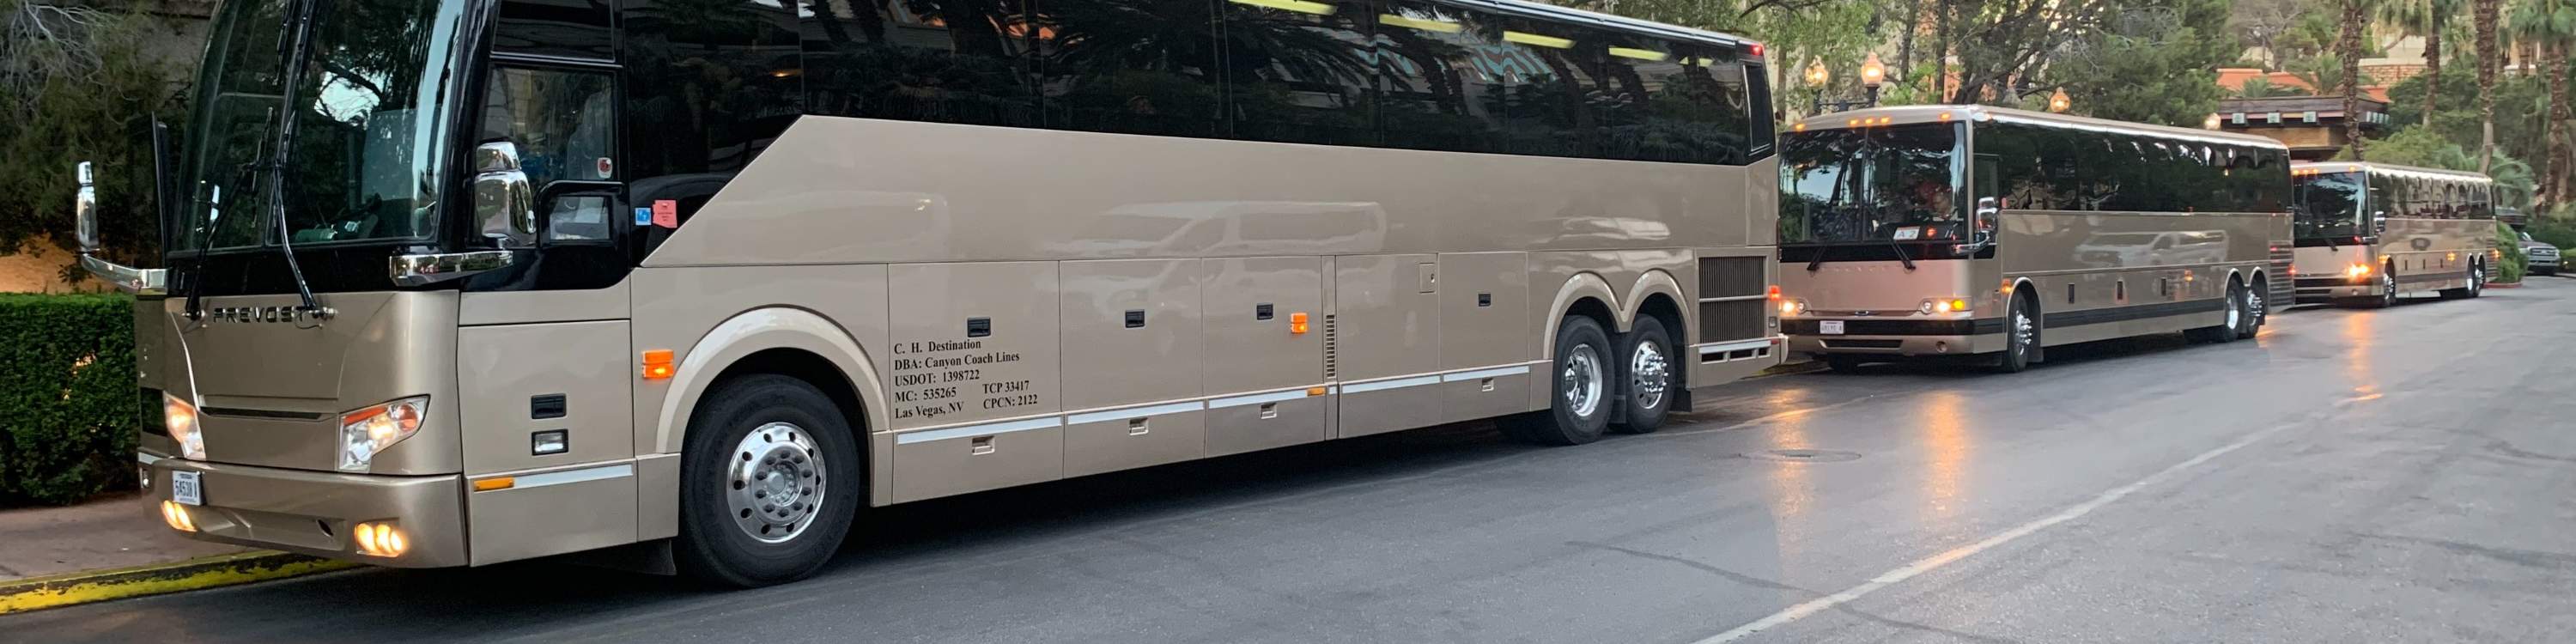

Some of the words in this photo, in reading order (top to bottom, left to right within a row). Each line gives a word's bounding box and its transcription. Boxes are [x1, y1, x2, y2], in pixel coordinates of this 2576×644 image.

[214, 307, 312, 323] PREVOST
[894, 343, 905, 355] C.
[911, 342, 922, 353] H.
[928, 339, 981, 352] Destination
[895, 359, 921, 370] DBA:
[925, 355, 962, 369] Canyon
[964, 353, 993, 365] Coach
[996, 351, 1020, 363] Lines
[895, 373, 937, 386] USDOT:
[943, 369, 980, 383] 1398722
[895, 391, 918, 403] MC:
[923, 386, 957, 400] 535265
[982, 383, 1003, 394] TCP
[1005, 380, 1030, 392] 33417
[896, 407, 913, 419] Las
[915, 404, 946, 418] Vegas,
[948, 401, 964, 413] NV
[983, 398, 1016, 410] CPCN:
[1018, 394, 1037, 406] 2122
